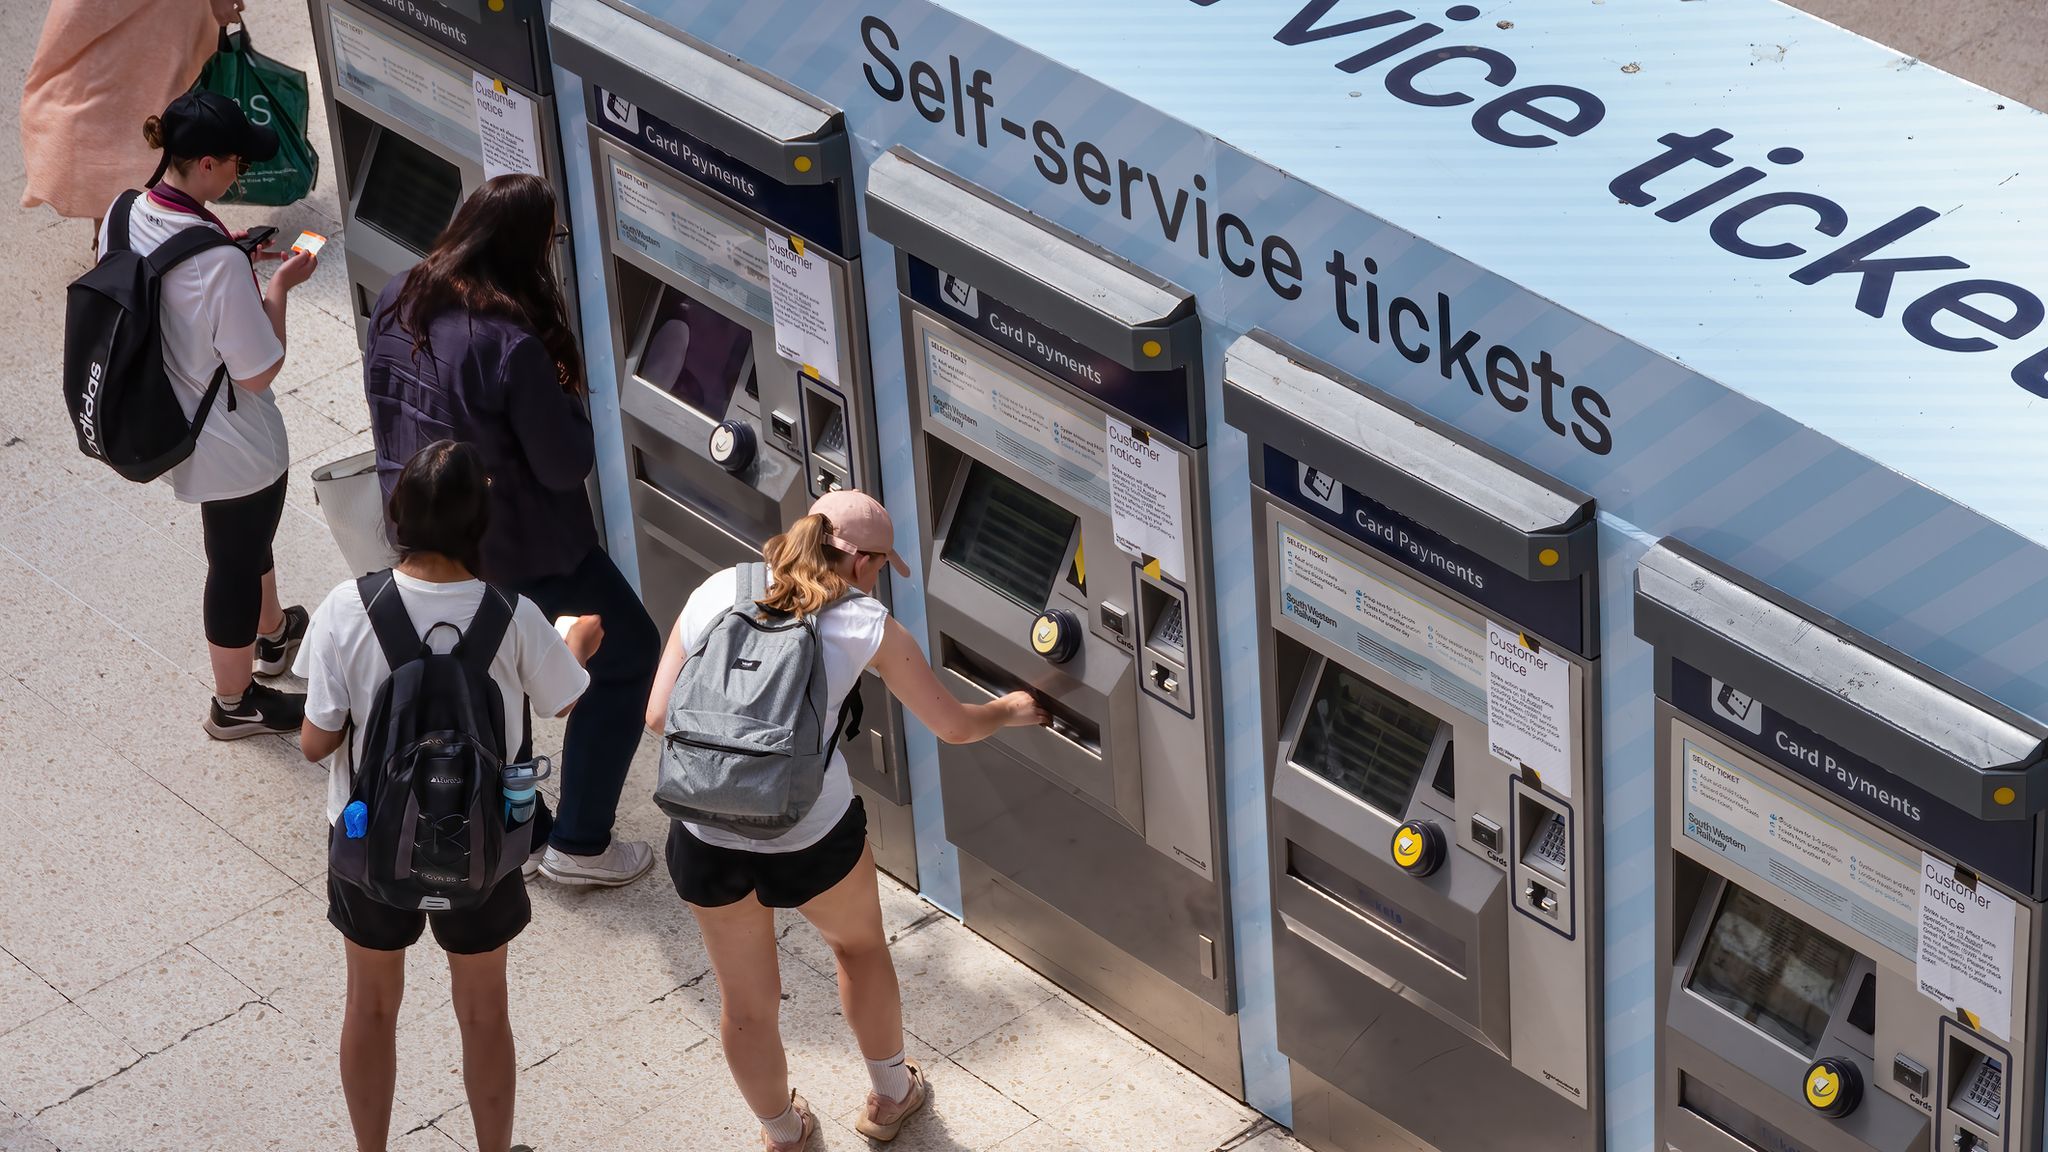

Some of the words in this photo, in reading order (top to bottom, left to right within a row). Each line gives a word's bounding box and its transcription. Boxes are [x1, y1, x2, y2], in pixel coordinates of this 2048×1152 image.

[381, 0, 405, 12] ard
[407, 1, 467, 45] Payments
[1190, 0, 1606, 149] vice
[475, 80, 518, 110] Customer
[477, 97, 503, 118] notice
[645, 125, 679, 157] Card
[683, 143, 755, 197] Payments
[860, 15, 1304, 301] Self-service
[1325, 249, 1614, 457] tickets
[768, 236, 812, 272] Customer
[769, 252, 797, 278] notice
[931, 340, 949, 356] SELECT
[989, 312, 1024, 345] Card
[1027, 333, 1102, 385] Payments
[79, 361, 102, 456] adidas
[932, 394, 952, 412] South
[951, 405, 977, 427] Western
[939, 407, 963, 428] Railway
[1109, 424, 1160, 463] Customer
[1109, 441, 1141, 469] notice
[1286, 536, 1307, 553] SELECT
[1308, 547, 1327, 563] TICKET
[1355, 508, 1394, 543] Card
[1399, 530, 1484, 590] Payments
[1286, 592, 1307, 612] South
[1307, 603, 1337, 628] Western
[1293, 605, 1321, 629] Railway
[1116, 636, 1134, 651] Cards
[1490, 629, 1547, 673] Customer
[1490, 646, 1526, 678] notice
[1692, 753, 1715, 772] SELECT
[1717, 766, 1739, 785] TICKET
[1775, 730, 1819, 768] Card
[1825, 756, 1922, 822] Payments
[1688, 812, 1711, 832] South
[1712, 825, 1746, 852] Western
[1696, 825, 1727, 852] Railway
[1487, 850, 1508, 867] Cards
[1925, 863, 1990, 911] Customer
[1925, 881, 1964, 914] notice
[1910, 1092, 1933, 1112] Cards
